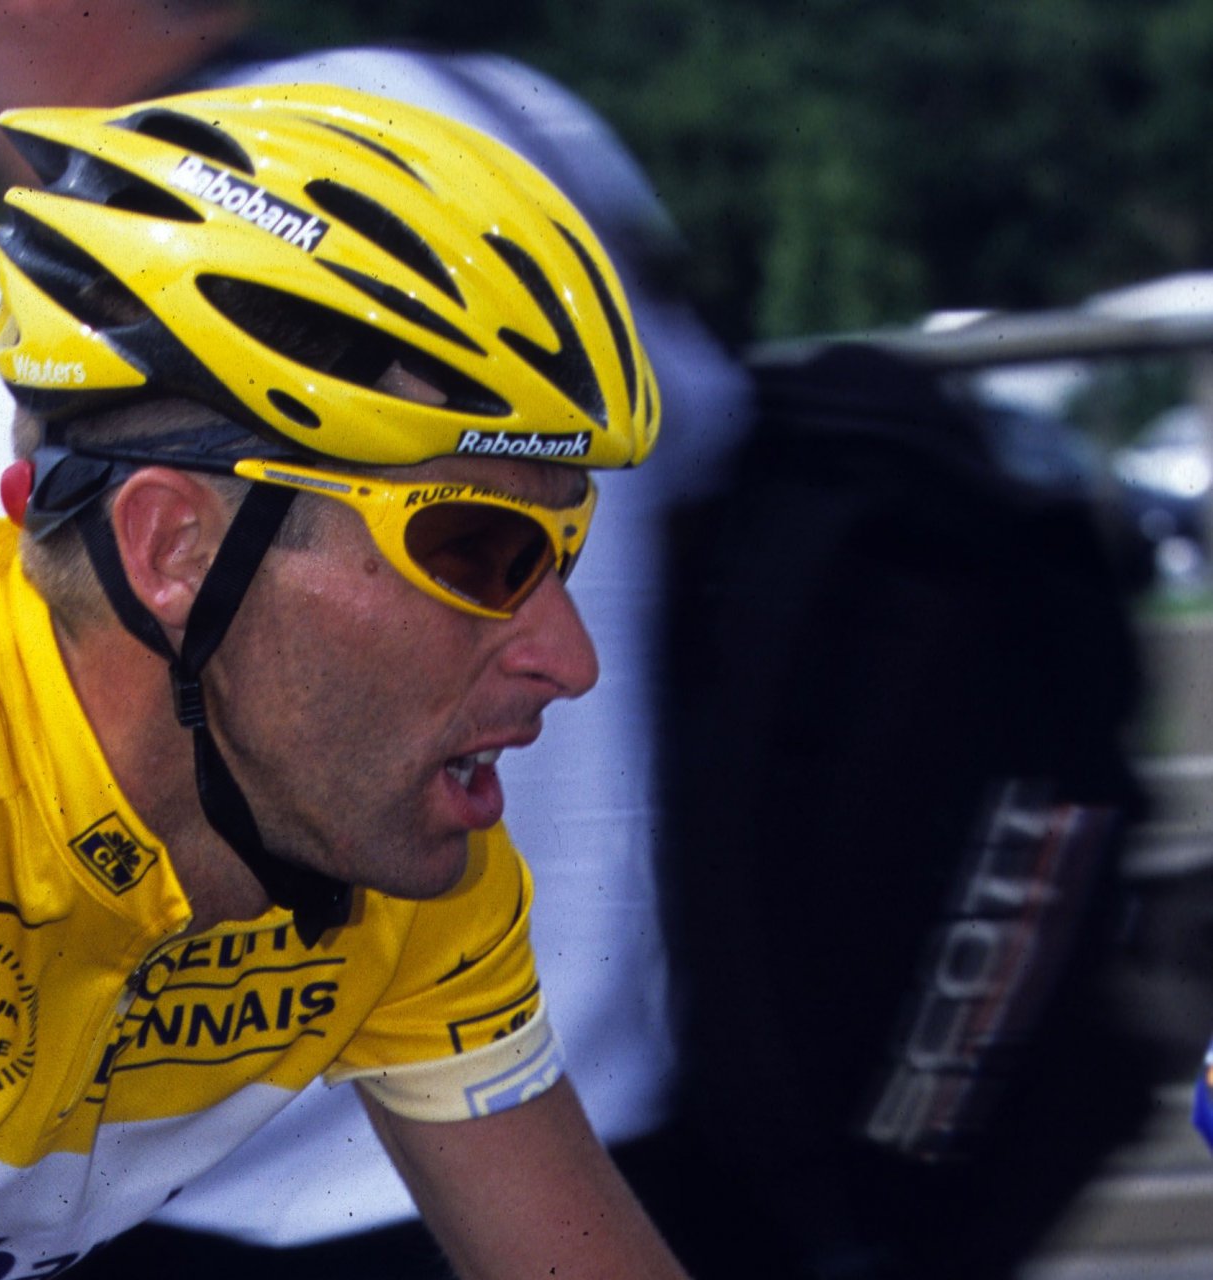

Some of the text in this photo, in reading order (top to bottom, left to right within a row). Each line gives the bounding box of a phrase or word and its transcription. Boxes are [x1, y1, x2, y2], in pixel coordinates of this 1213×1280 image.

[170, 153, 323, 253] Rabobank
[13, 353, 87, 385] Wauters
[457, 429, 589, 457] Rabobank
[404, 486, 534, 510] RUDY PROJECT
